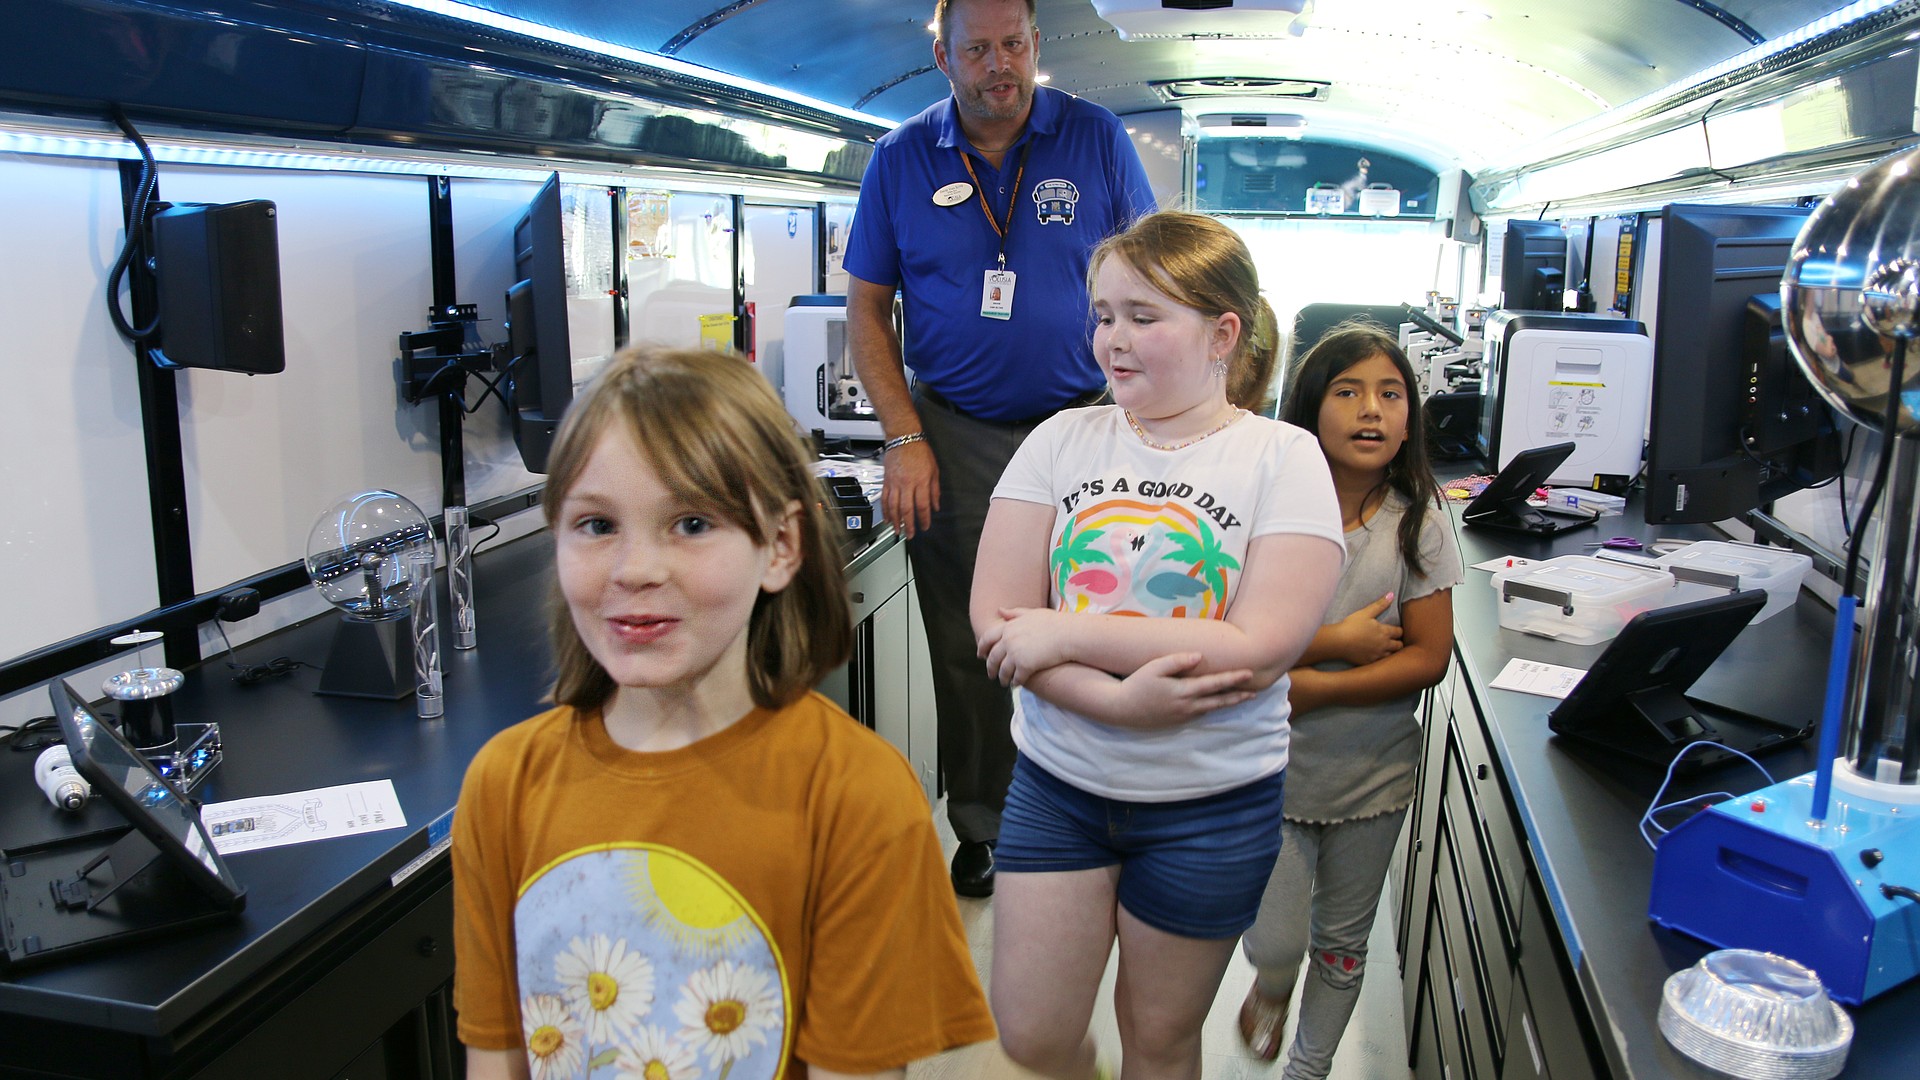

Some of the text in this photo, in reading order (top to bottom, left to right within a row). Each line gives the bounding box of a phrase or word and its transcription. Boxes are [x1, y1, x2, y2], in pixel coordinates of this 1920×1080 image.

[989, 275, 1012, 283] VOLUSIA
[1062, 478, 1242, 530] IT'S A GOOD DAY
